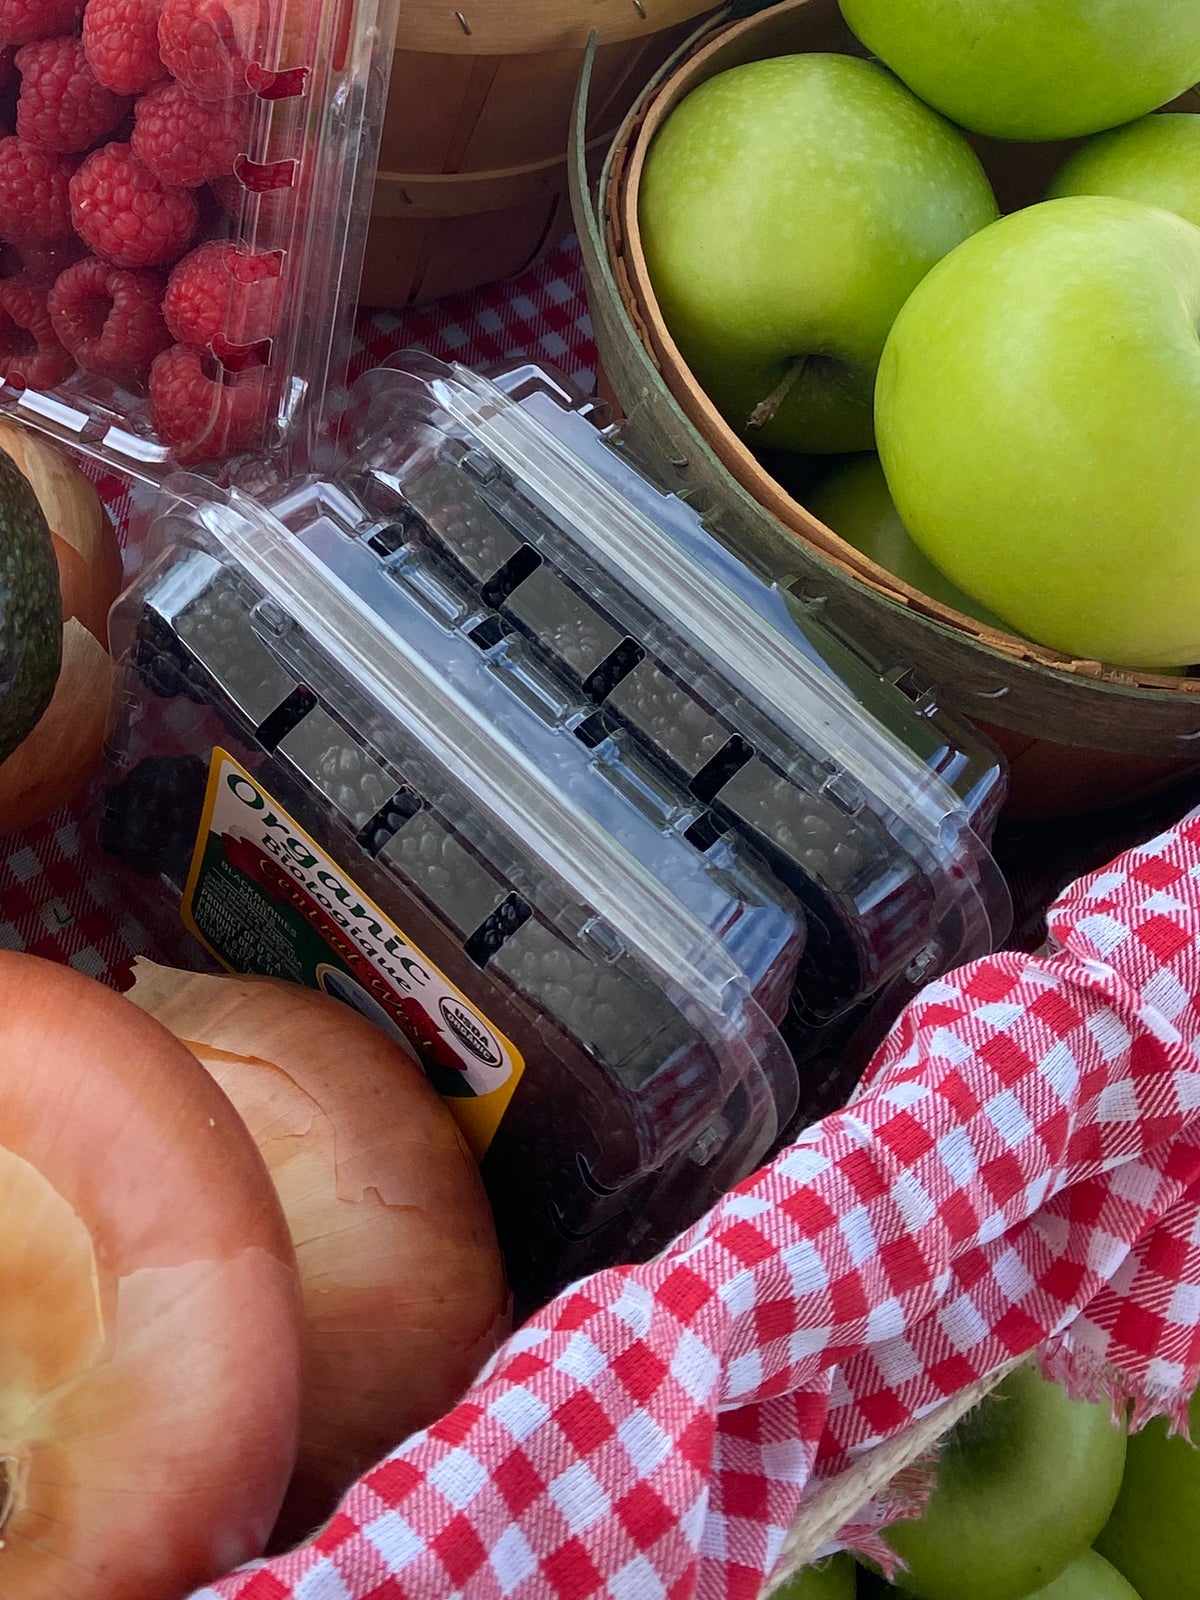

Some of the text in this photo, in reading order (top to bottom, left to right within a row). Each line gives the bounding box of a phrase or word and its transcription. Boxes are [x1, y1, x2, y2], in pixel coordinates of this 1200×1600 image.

[199, 887, 241, 931] PRODUCT
[221, 860, 297, 938] BLACKBERRIES
[226, 773, 431, 987] Organic
[197, 896, 236, 937] PRODUIT
[261, 833, 411, 993] Biologique
[259, 858, 432, 1048] Central West
[444, 1010, 494, 1060] ORGANIC
[453, 1006, 489, 1050] USDA
